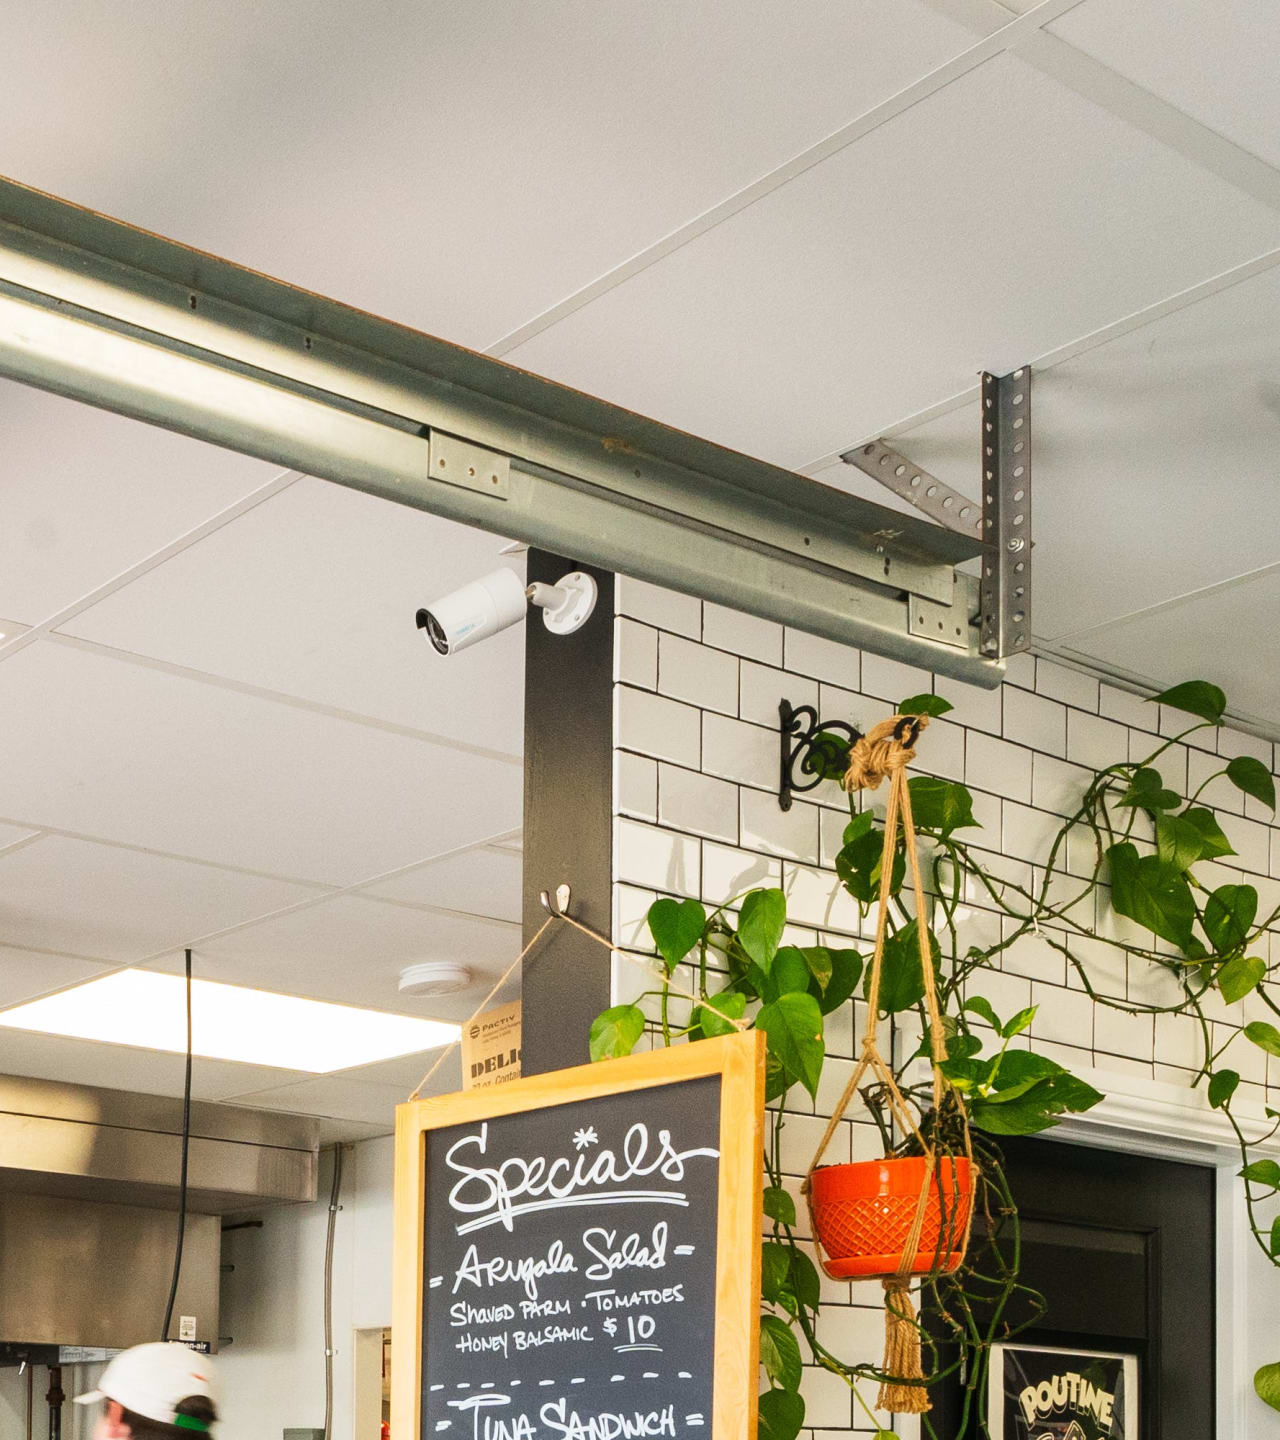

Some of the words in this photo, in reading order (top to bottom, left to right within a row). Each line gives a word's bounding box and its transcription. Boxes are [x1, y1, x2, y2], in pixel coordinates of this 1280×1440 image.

[446, 1122, 720, 1232] Specials
[582, 1221, 668, 1280] Salad
[522, 1300, 570, 1318] PARM
[585, 1284, 684, 1310] TOMATOES
[456, 1332, 508, 1359] HONEY
[513, 1326, 594, 1350] BALSAMIC
[628, 1316, 656, 1344] 10
[1019, 1371, 1114, 1432] POUTINE
